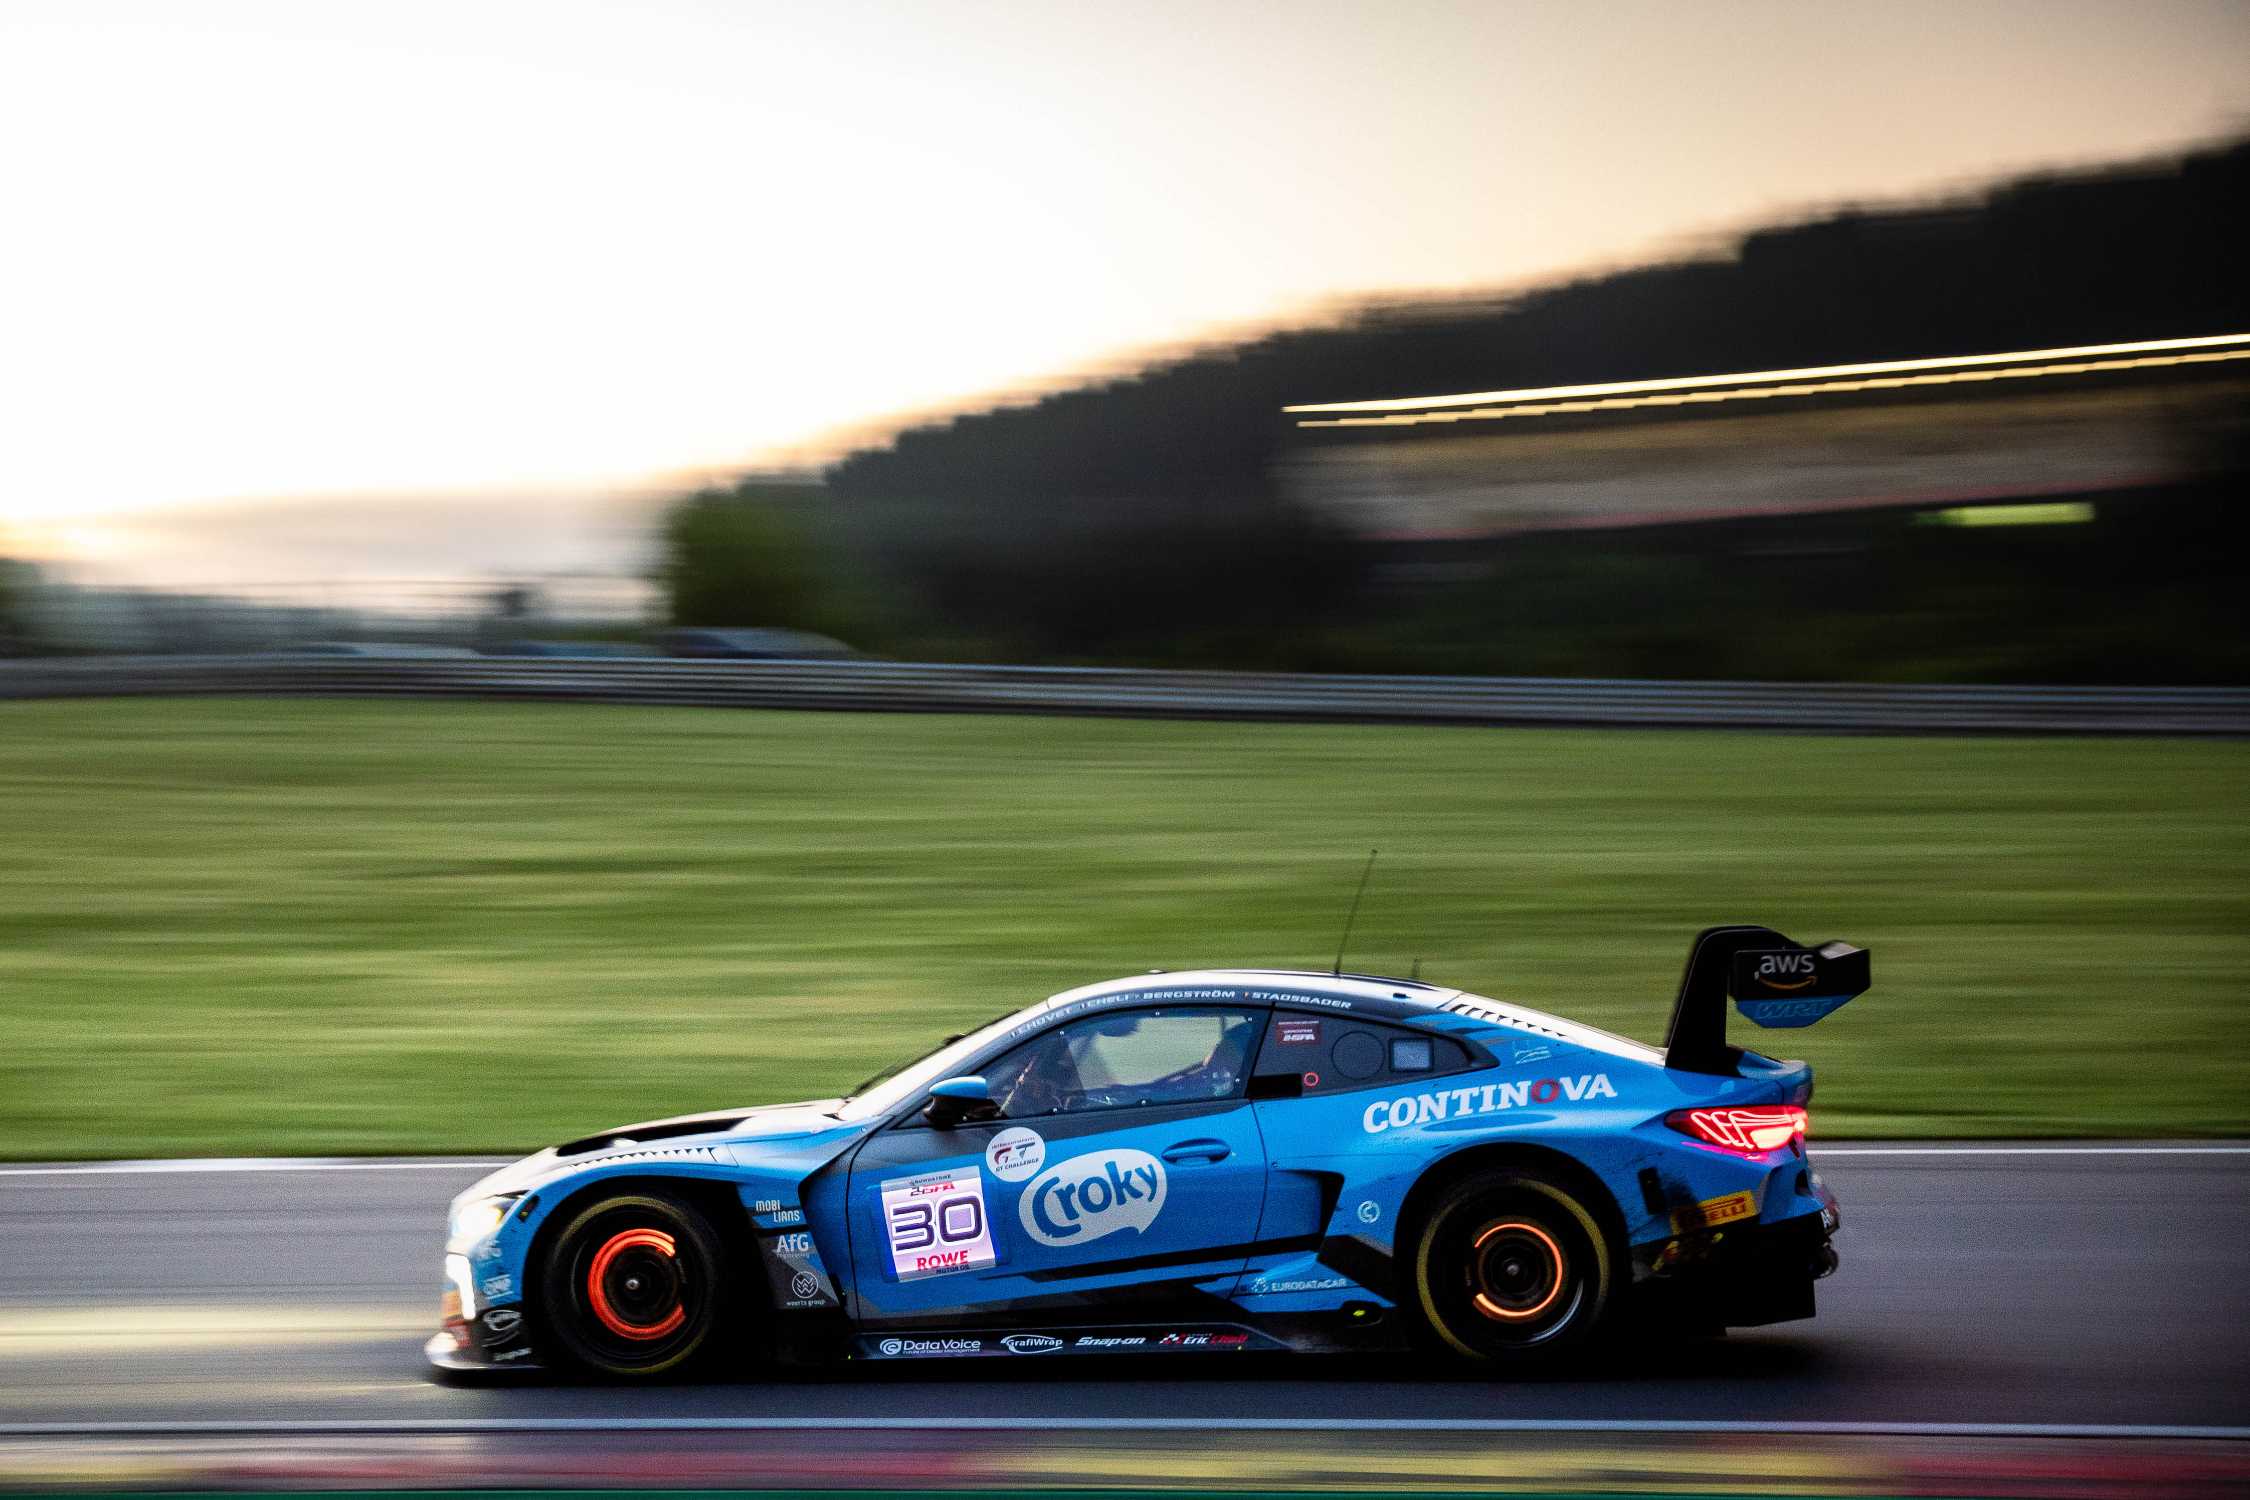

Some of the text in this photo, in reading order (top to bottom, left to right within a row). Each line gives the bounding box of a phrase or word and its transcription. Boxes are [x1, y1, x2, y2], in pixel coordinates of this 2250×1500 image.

[1760, 954, 1815, 974] aws
[1143, 990, 1236, 1000] BERGSTRÖM
[1252, 991, 1352, 1009] STADSBADER
[1363, 1073, 1618, 1133] CONTINOVA
[1032, 1161, 1158, 1238] Croky
[893, 1195, 983, 1252] 30
[917, 1250, 969, 1271] ROWE
[1271, 1278, 1347, 1292] EURODATACAR
[1007, 1337, 1063, 1347] GrafiWrap
[1075, 1336, 1146, 1347] Snap-on
